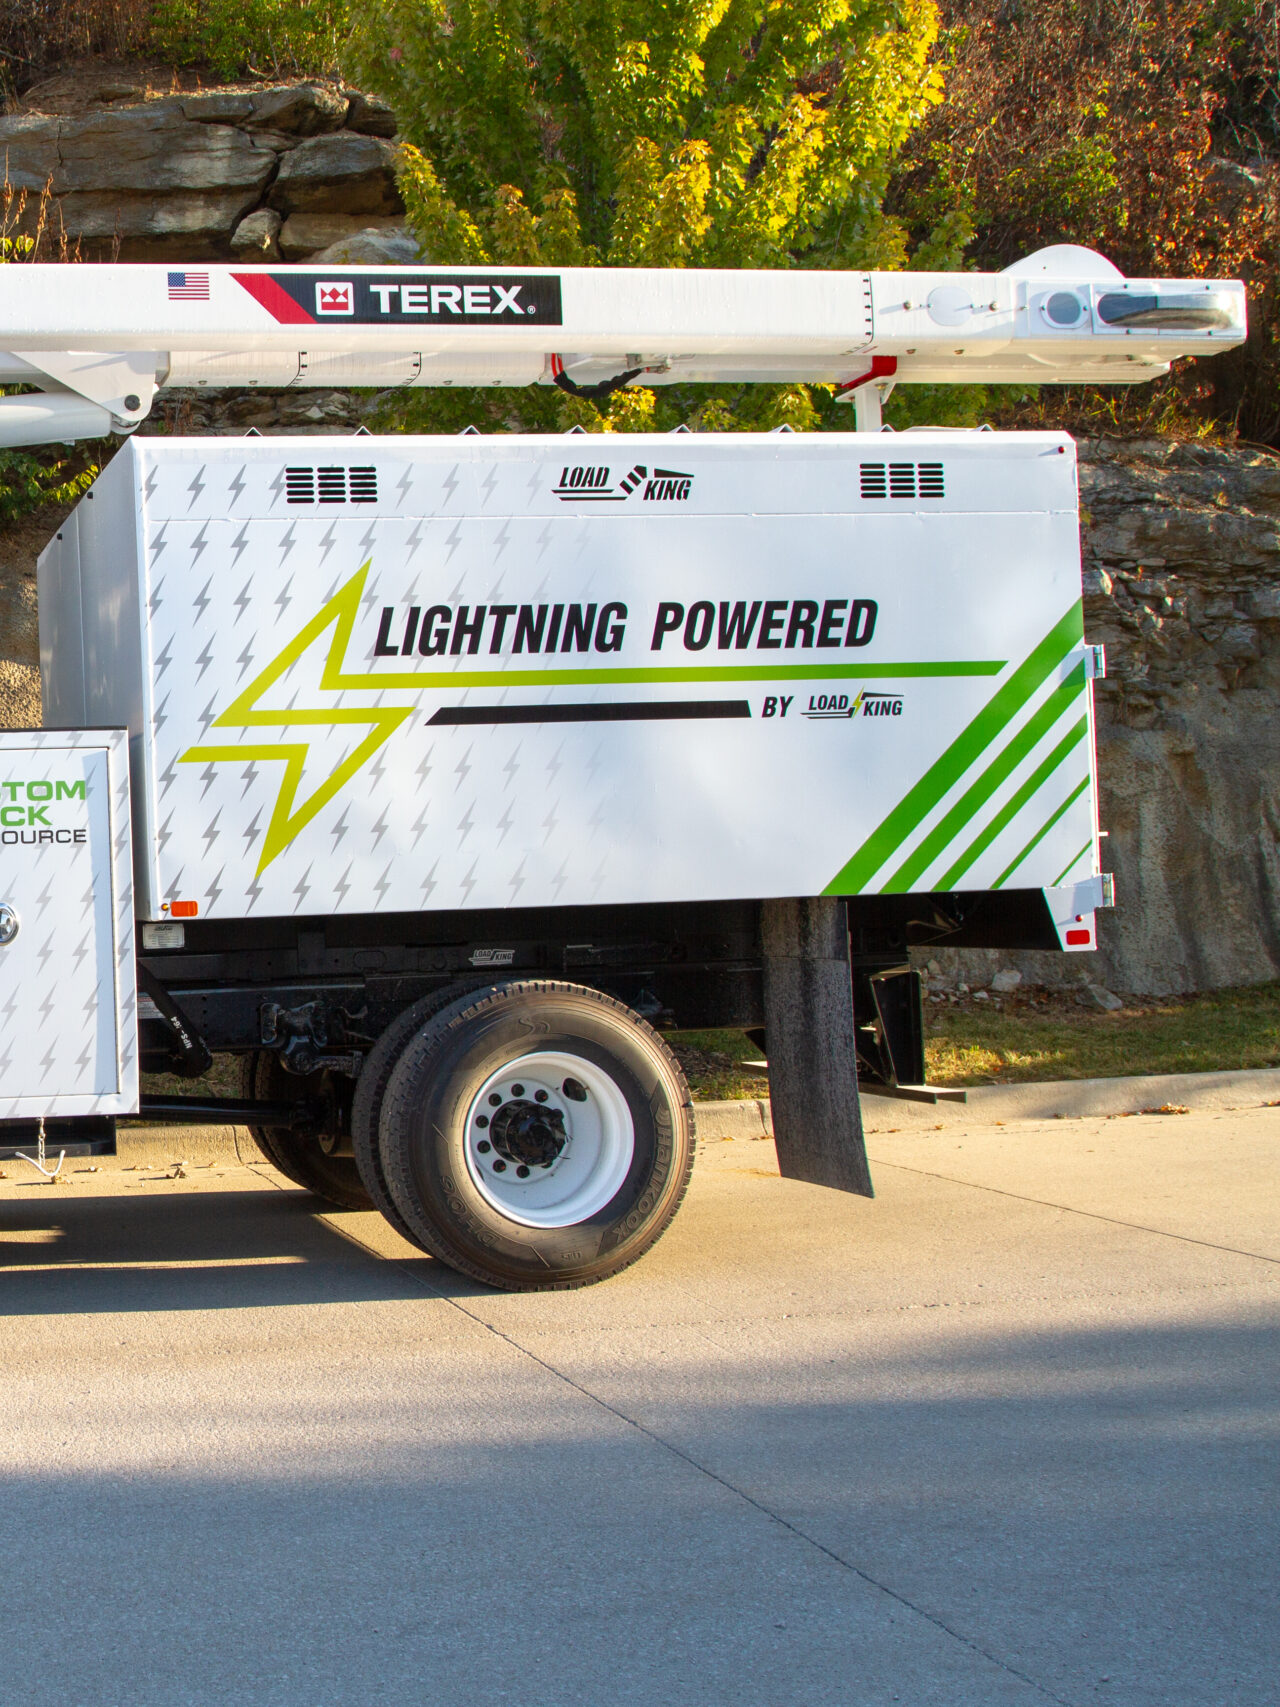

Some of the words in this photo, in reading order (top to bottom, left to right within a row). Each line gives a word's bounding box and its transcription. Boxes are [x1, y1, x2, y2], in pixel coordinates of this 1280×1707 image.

[559, 467, 610, 488] LOAD
[643, 479, 692, 501] KING
[373, 600, 628, 657] LIGHTNING
[650, 598, 878, 651] POWERED
[761, 695, 794, 718] BY
[808, 694, 849, 711] LOAD
[863, 700, 903, 717] KING
[474, 950, 491, 958] LOAD
[494, 952, 513, 961] KING
